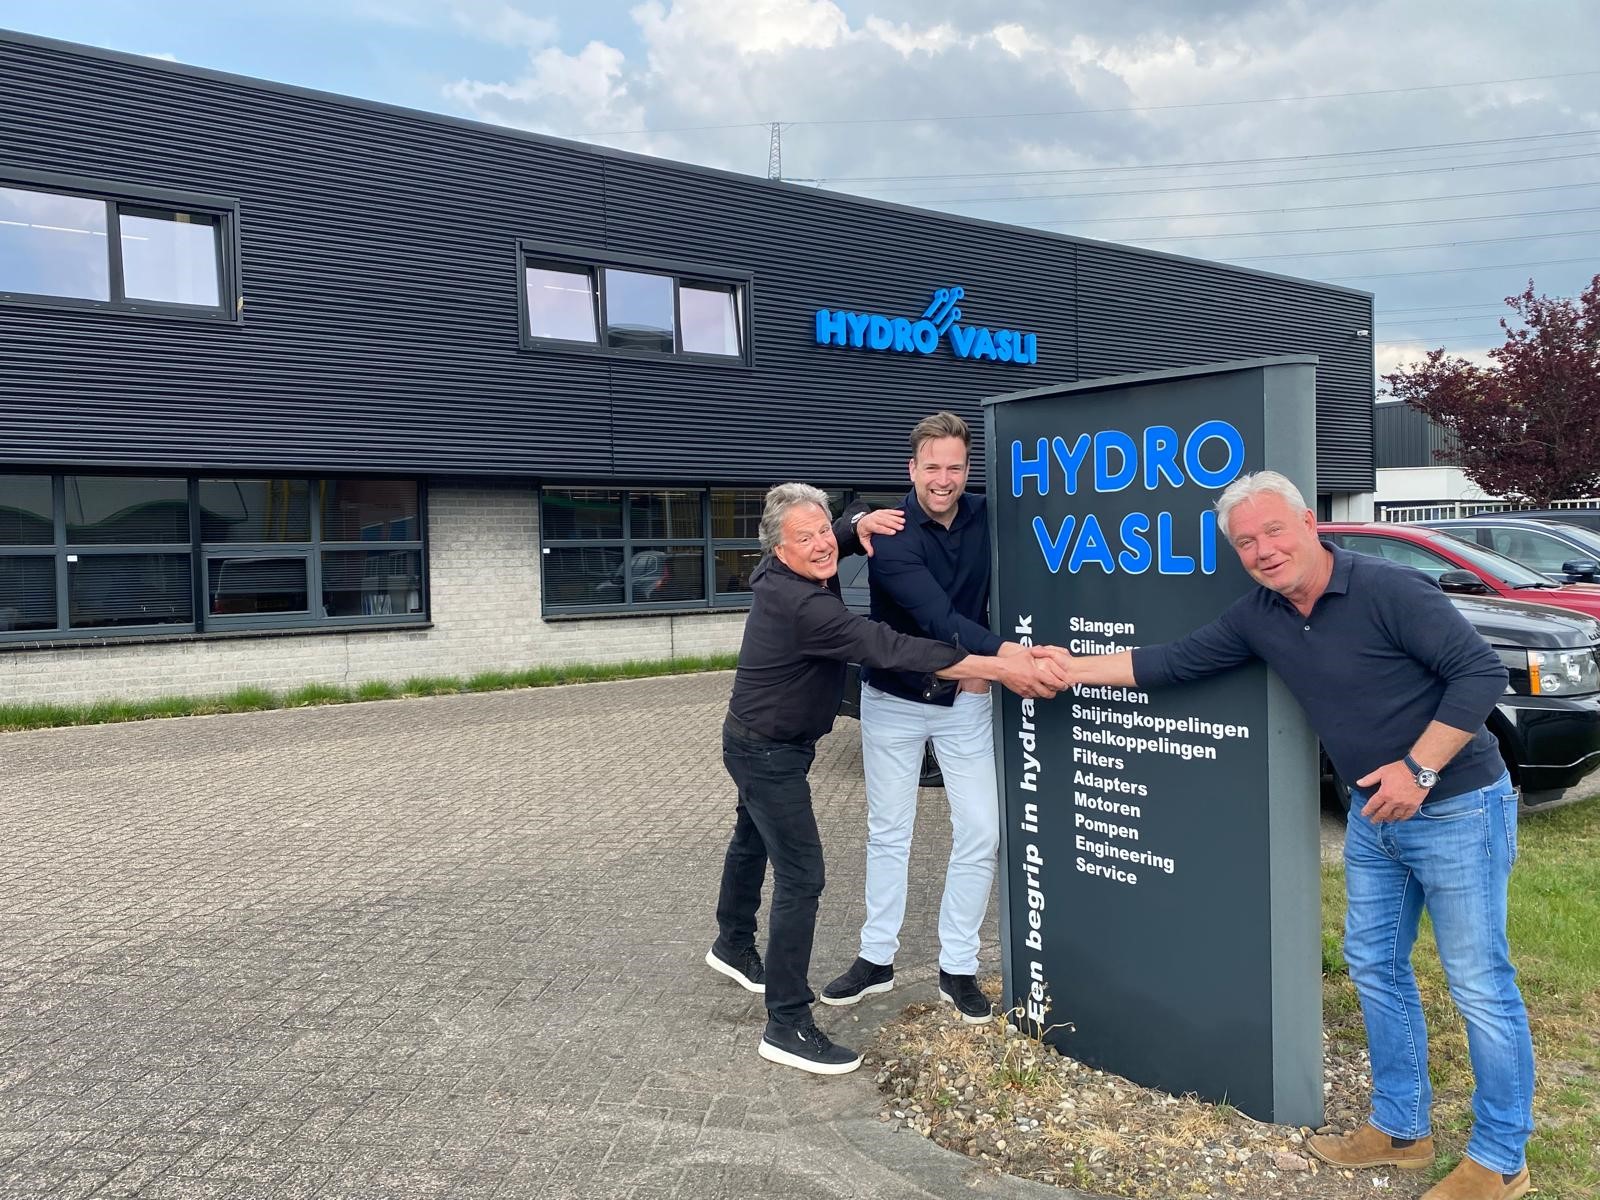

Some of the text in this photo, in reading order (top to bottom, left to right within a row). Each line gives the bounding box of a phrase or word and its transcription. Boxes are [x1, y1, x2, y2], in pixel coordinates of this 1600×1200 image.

[816, 308, 1037, 365] HYDRO VASLI
[1011, 420, 1246, 497] HYDRO
[1032, 510, 1217, 575] VASLI
[1069, 616, 1135, 637] Slangen
[1069, 638, 1141, 655] Cilinder
[1072, 682, 1149, 705] Ventielen
[1071, 704, 1250, 740] Snijringkoppelingen
[1072, 725, 1217, 761] Snelkoppelingen
[1073, 747, 1125, 770] Filters
[1073, 769, 1148, 797] Adapters
[1015, 614, 1045, 1024] Een begrip in hydraek
[1074, 791, 1141, 818] Motoren
[1075, 812, 1139, 841] Pompen
[1075, 834, 1175, 874] Engineering
[1076, 856, 1138, 885] Service
